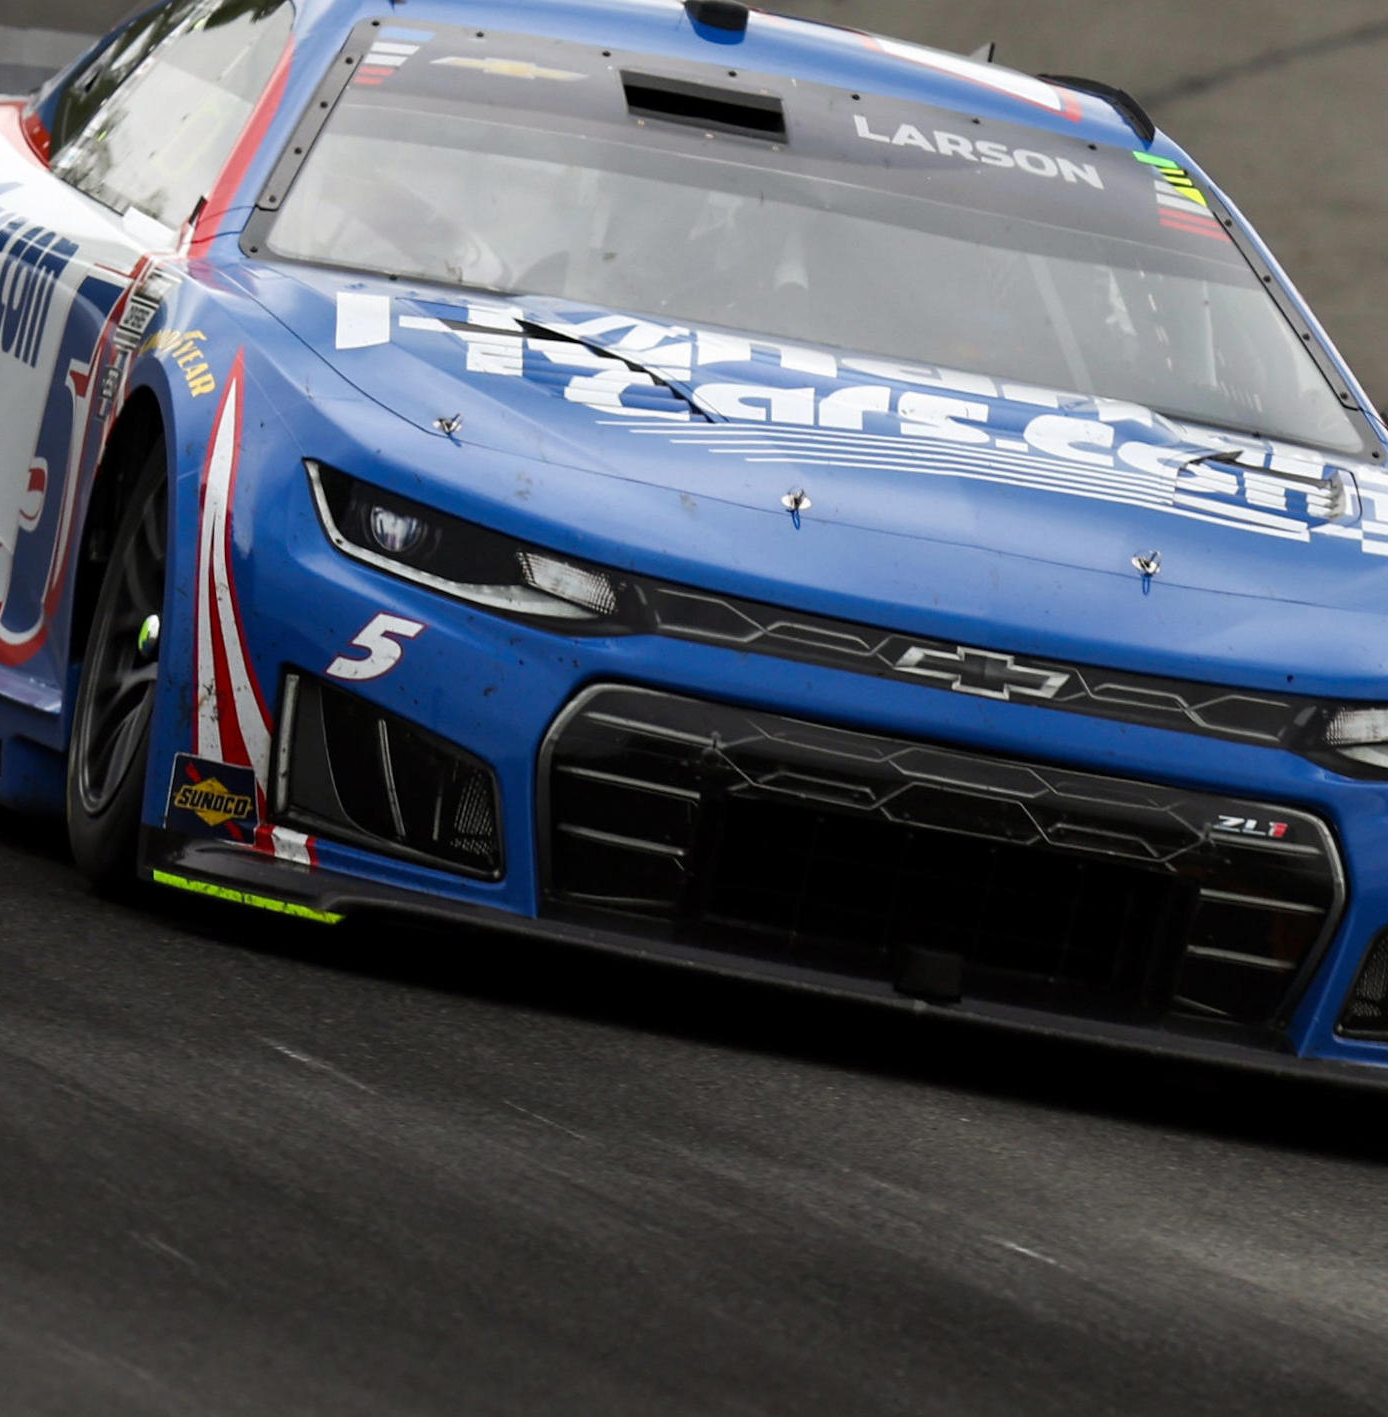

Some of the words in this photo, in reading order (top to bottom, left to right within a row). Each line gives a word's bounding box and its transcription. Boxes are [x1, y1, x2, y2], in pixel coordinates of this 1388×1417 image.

[853, 114, 1105, 190] LARSON
[325, 611, 429, 681] 5
[175, 786, 251, 818] SUNOCO
[1212, 814, 1288, 839] ZL1
